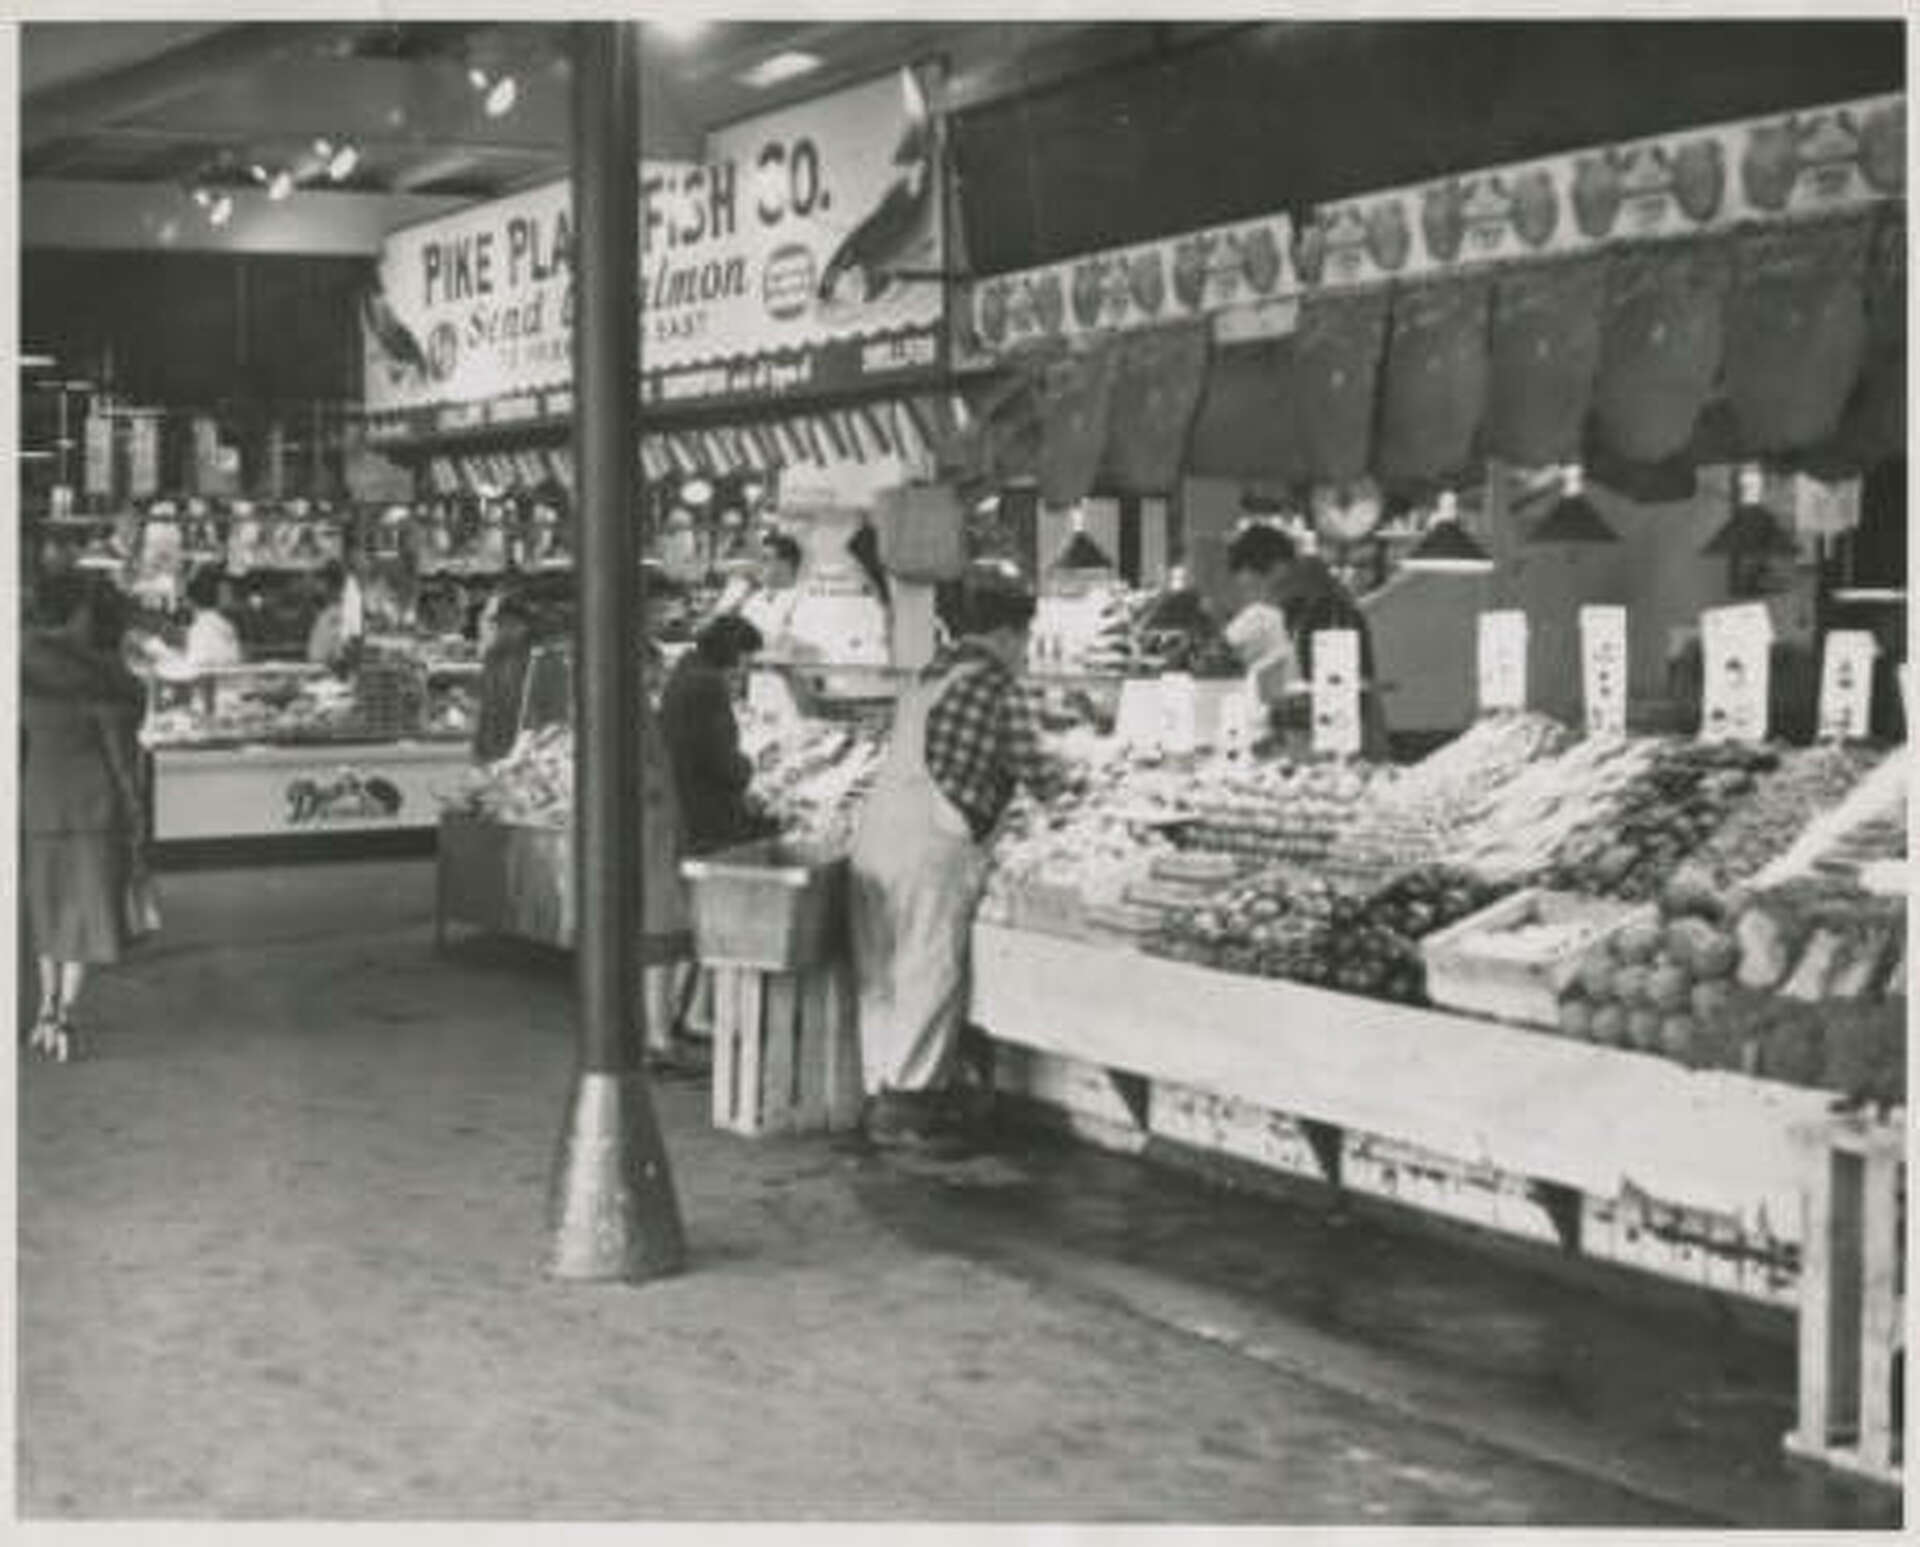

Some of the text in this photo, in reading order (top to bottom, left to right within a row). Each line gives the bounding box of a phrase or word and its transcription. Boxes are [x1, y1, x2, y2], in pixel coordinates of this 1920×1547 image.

[424, 233, 494, 306] PIKE
[508, 212, 573, 288] PLA
[641, 160, 736, 254] FISH
[757, 137, 831, 229] CO.
[643, 255, 745, 311] lmon
